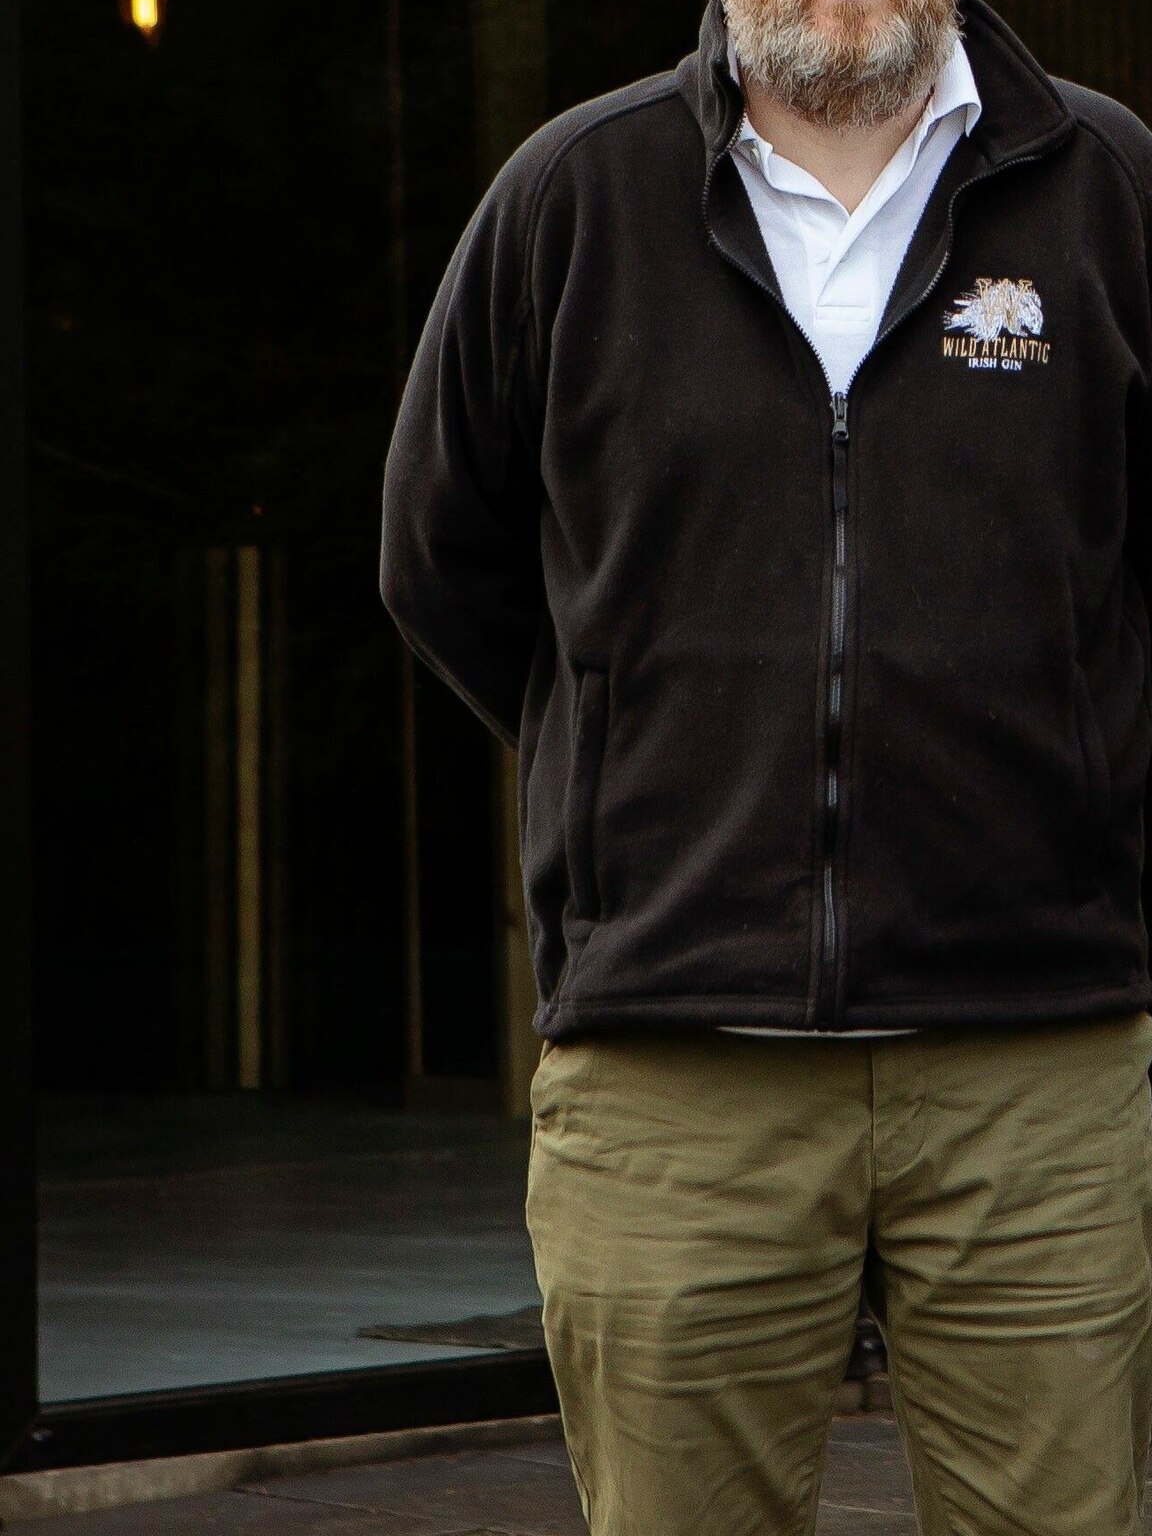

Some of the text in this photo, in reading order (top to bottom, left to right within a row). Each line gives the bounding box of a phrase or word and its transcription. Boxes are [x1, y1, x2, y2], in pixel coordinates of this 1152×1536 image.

[942, 336, 1051, 364] WILD ATLANTIC
[968, 357, 1022, 371] IRISH GIN
